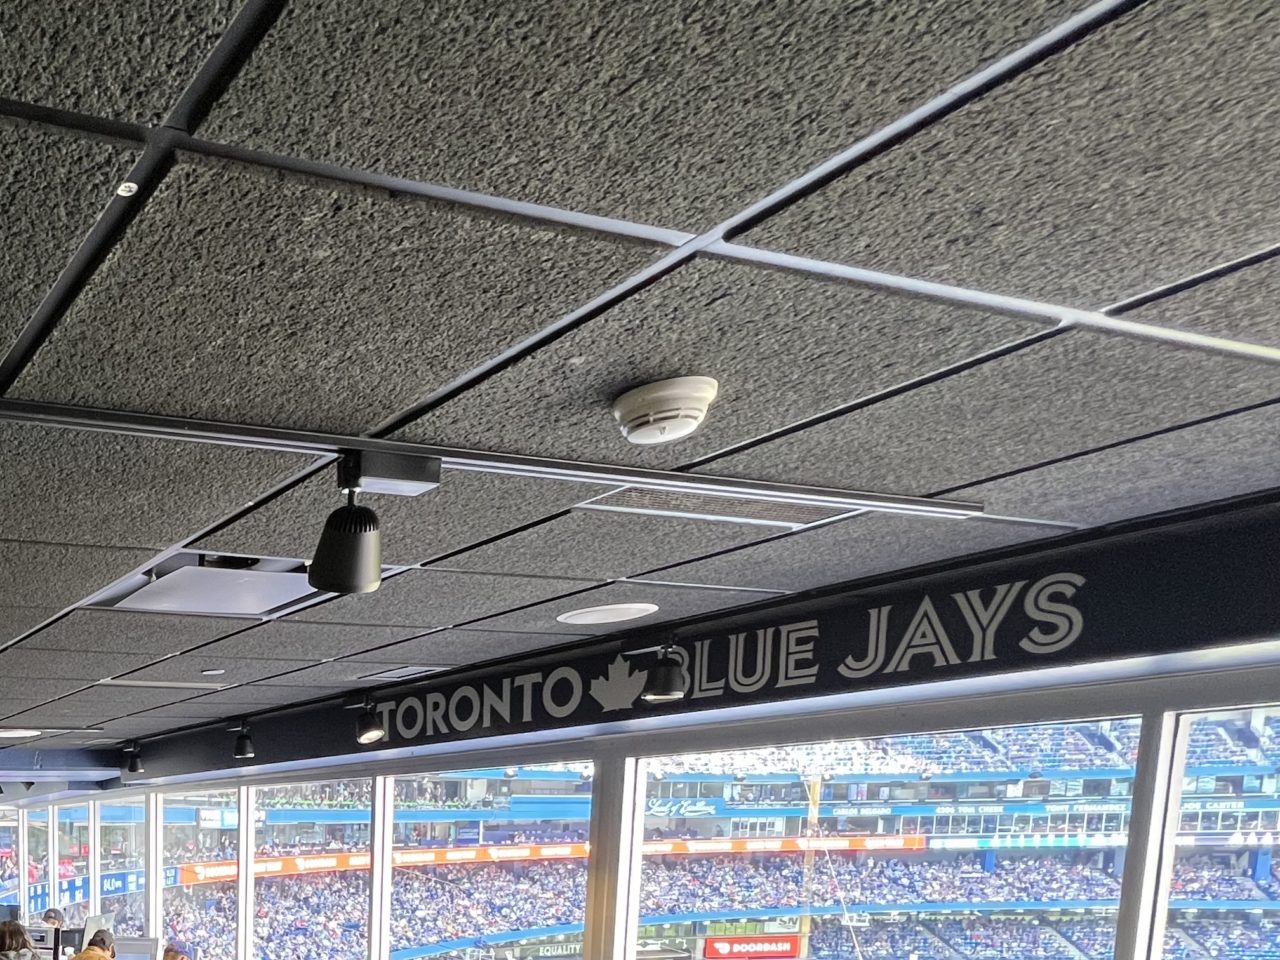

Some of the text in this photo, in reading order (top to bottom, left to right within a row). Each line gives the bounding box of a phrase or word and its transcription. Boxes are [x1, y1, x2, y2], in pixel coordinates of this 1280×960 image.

[376, 666, 583, 742] TORONTO
[837, 572, 1087, 679] JAYS
[539, 944, 581, 957] EQUALITY
[732, 942, 791, 953] DOORDASH
